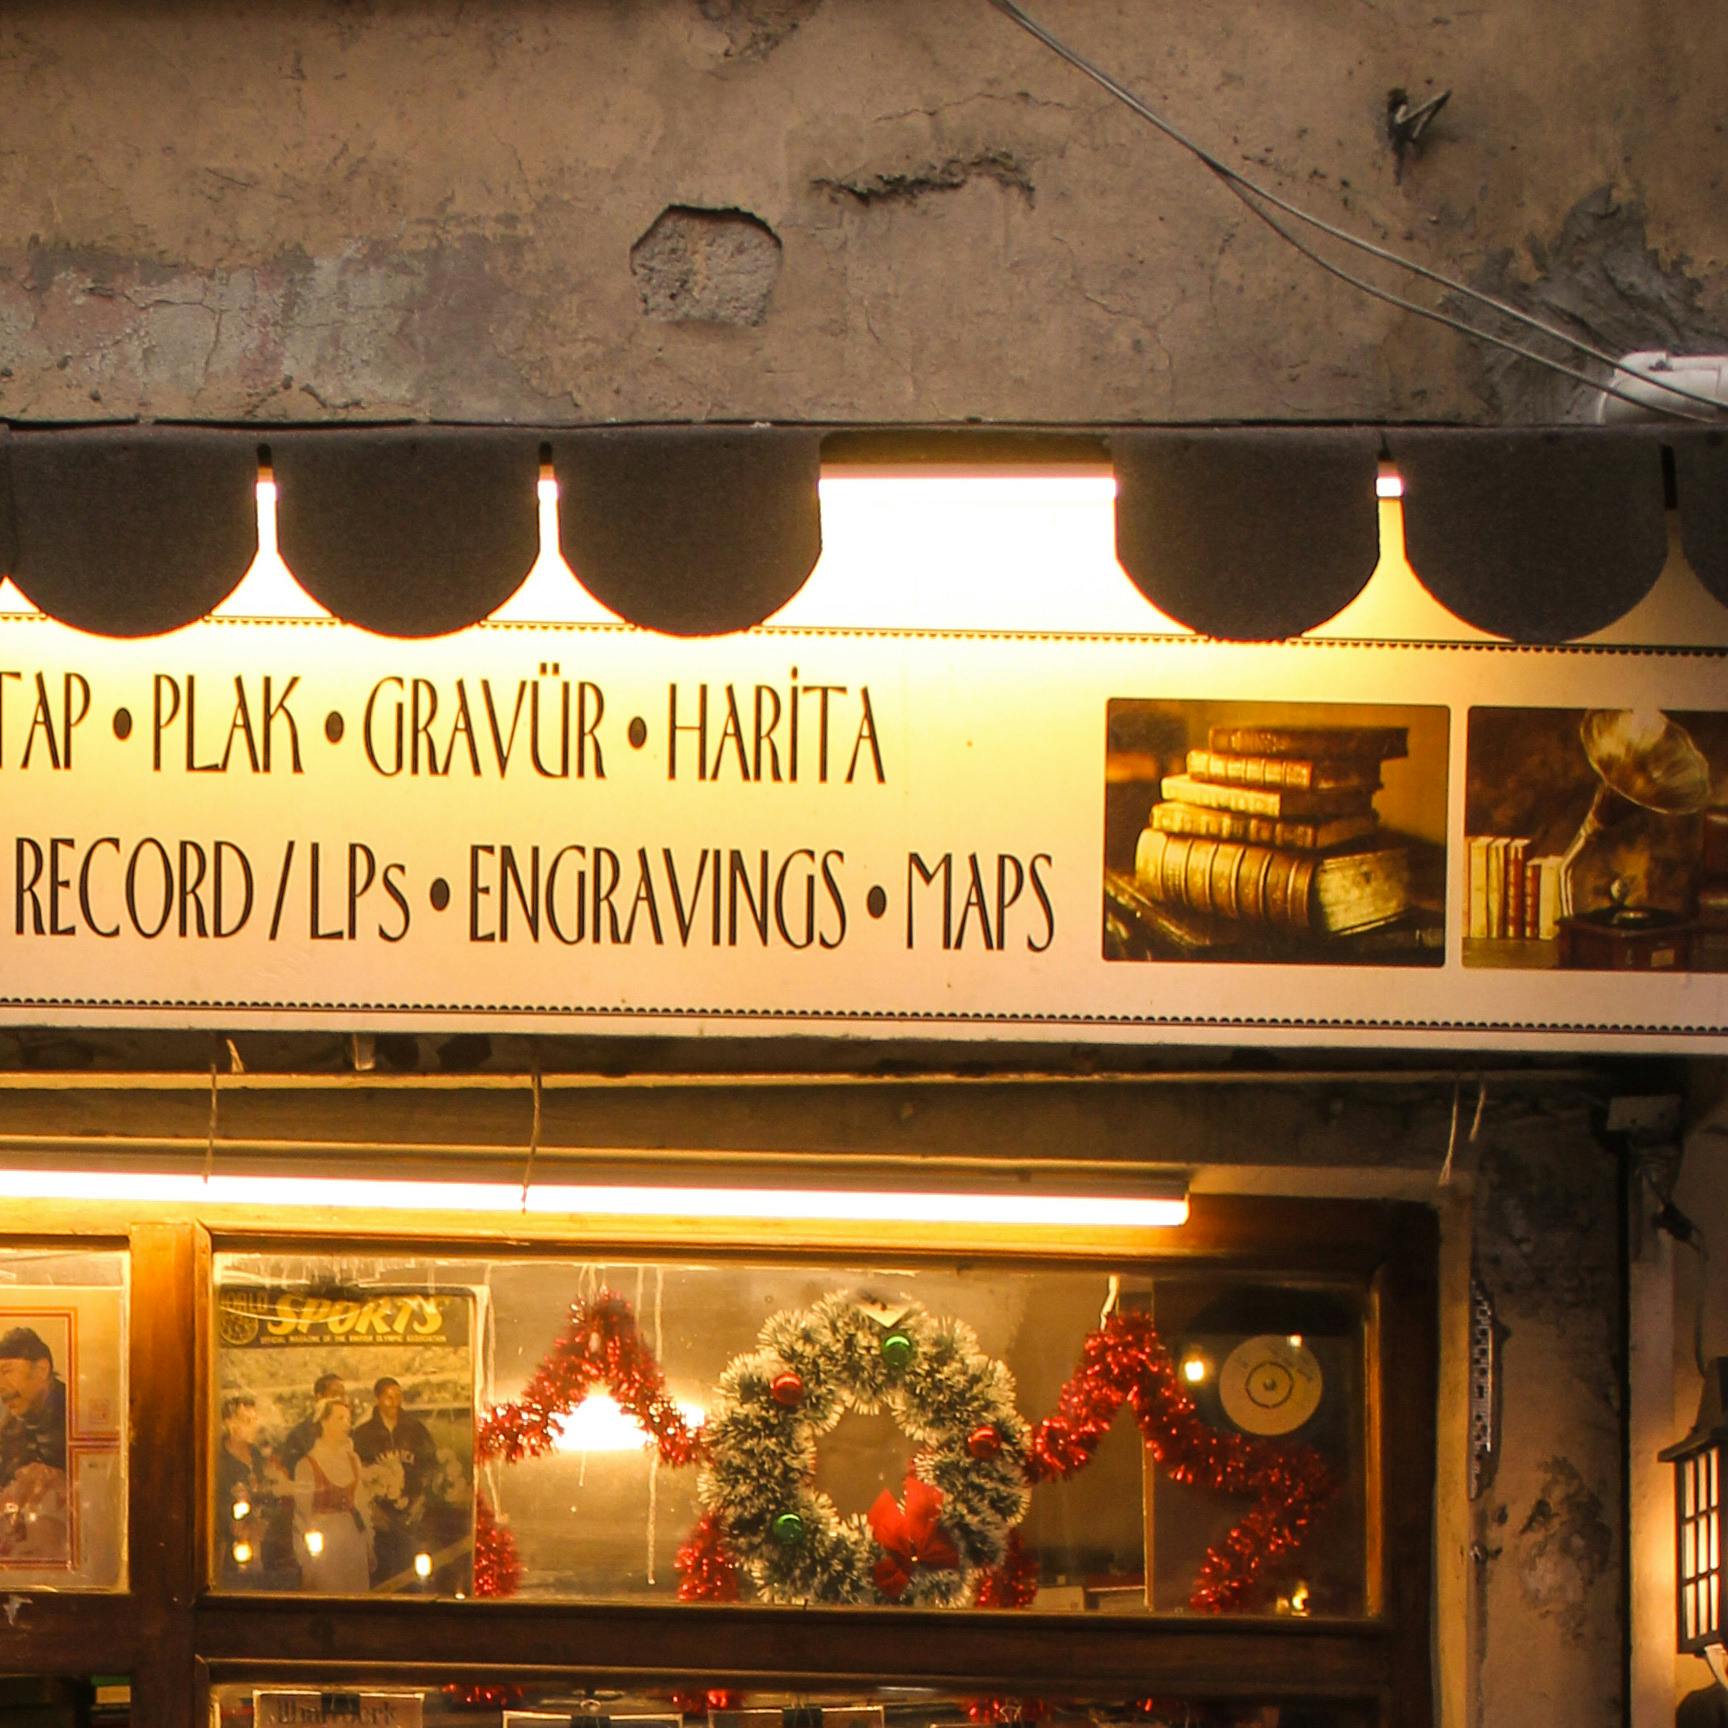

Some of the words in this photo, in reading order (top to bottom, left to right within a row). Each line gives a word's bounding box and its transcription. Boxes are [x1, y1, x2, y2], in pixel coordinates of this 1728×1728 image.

[153, 673, 303, 774] PLAK
[364, 662, 607, 779] GRAVÜR
[668, 667, 887, 785] HARİTA
[470, 845, 847, 950] ENGRAVINGS
[906, 851, 1054, 952] MAPS
[267, 1293, 444, 1335] SPORTS
